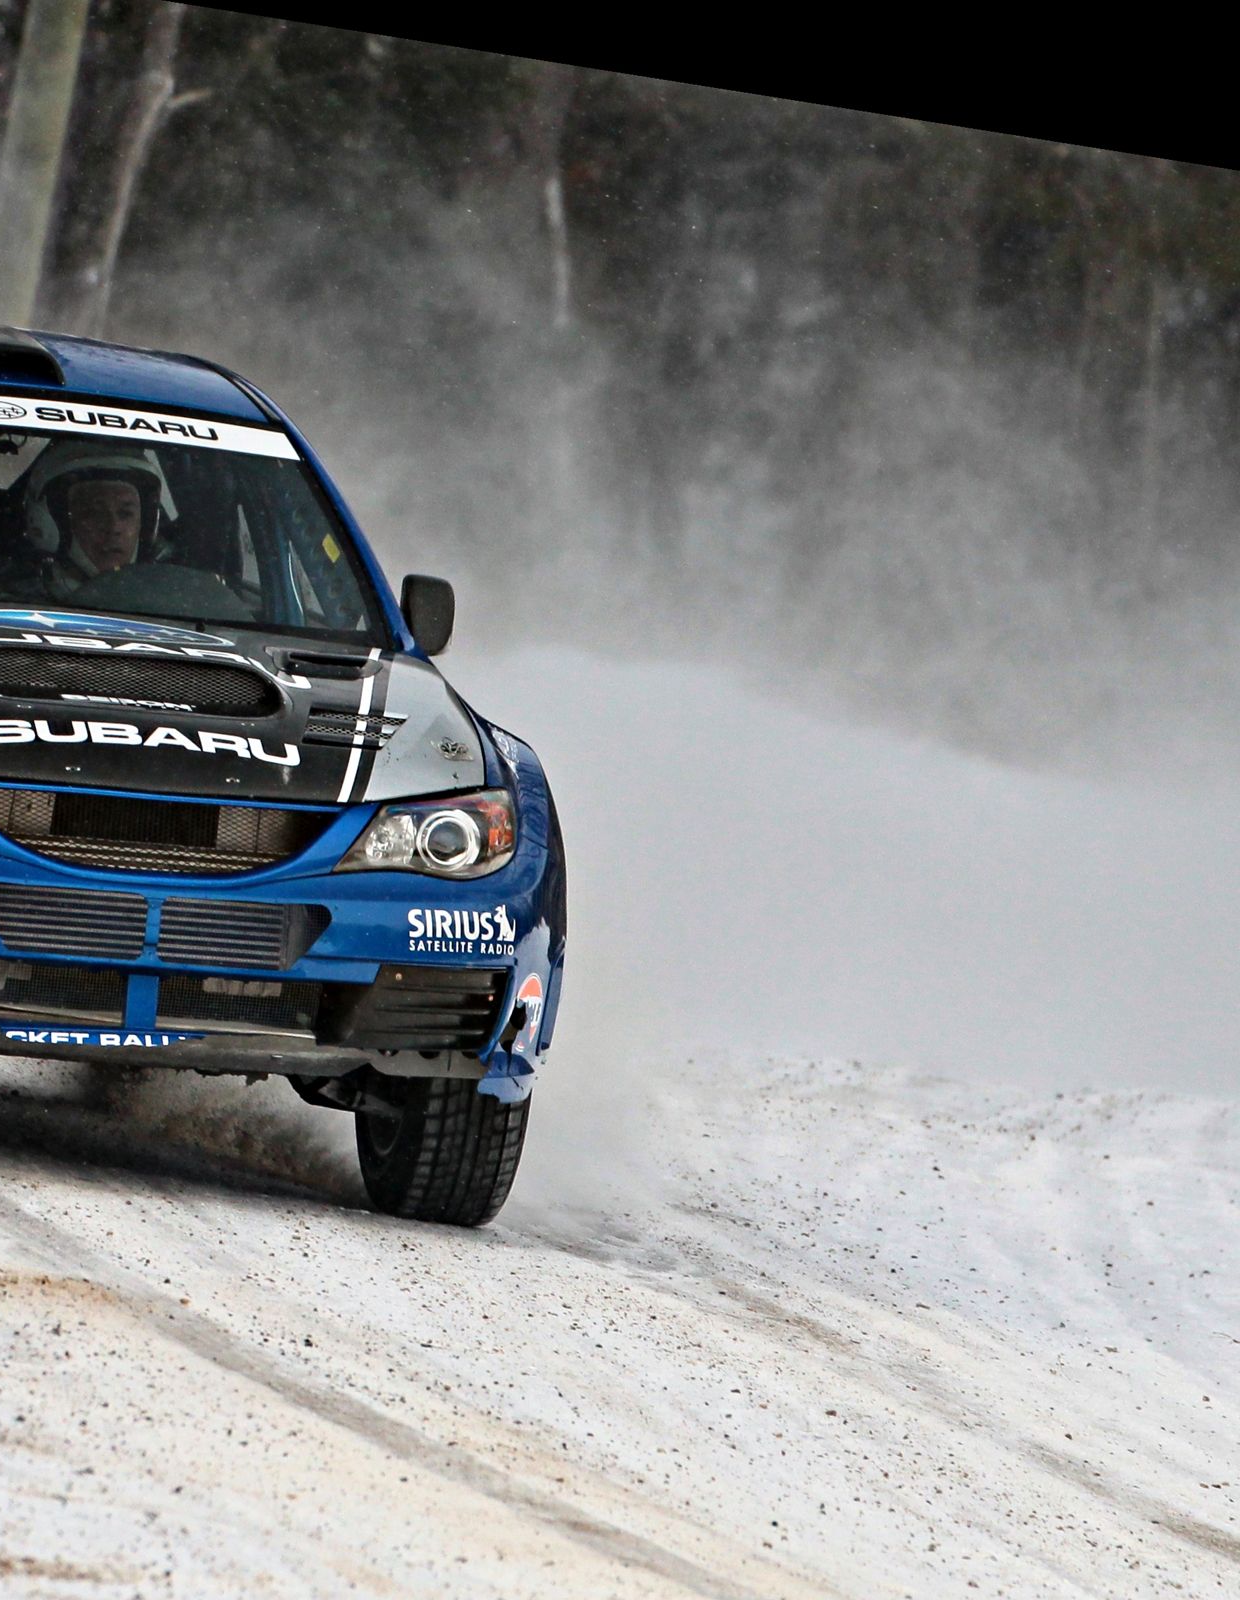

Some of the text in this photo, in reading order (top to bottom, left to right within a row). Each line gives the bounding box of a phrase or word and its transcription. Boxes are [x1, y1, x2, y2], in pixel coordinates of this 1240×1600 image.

[35, 406, 219, 442] SUBARU
[407, 908, 494, 941] SIRIUS
[409, 939, 515, 956] SATELLITE RADIO
